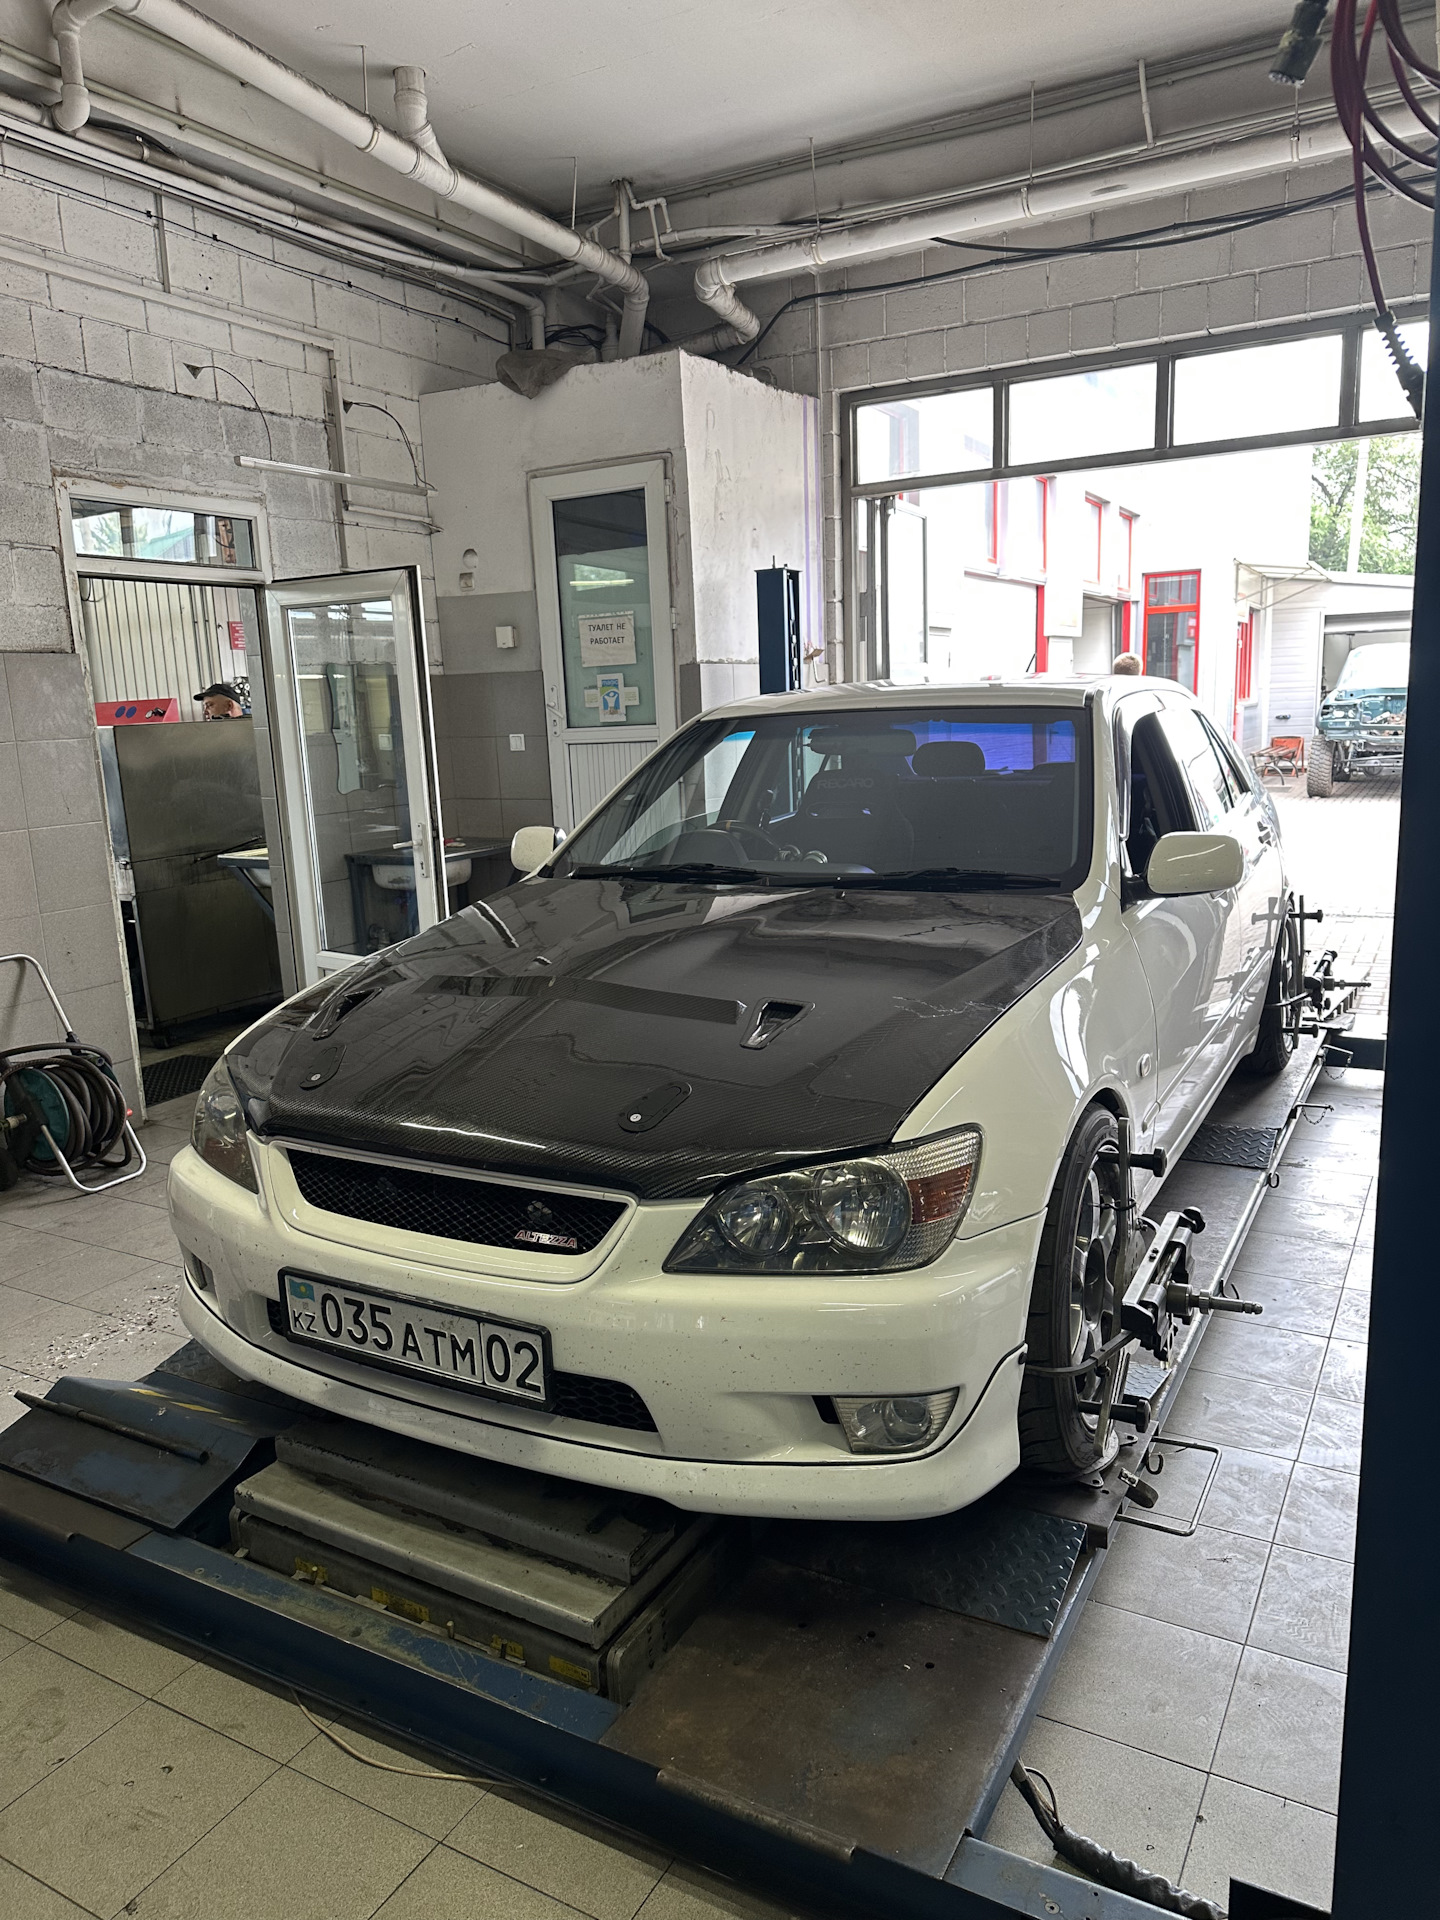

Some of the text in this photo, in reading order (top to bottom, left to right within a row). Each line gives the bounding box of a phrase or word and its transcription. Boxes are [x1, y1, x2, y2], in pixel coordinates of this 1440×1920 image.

[590, 637, 625, 645] РАБОТАЕТ
[817, 778, 873, 789] RECARO
[514, 1230, 577, 1248] ALTEZZA
[292, 1309, 317, 1334] KZ
